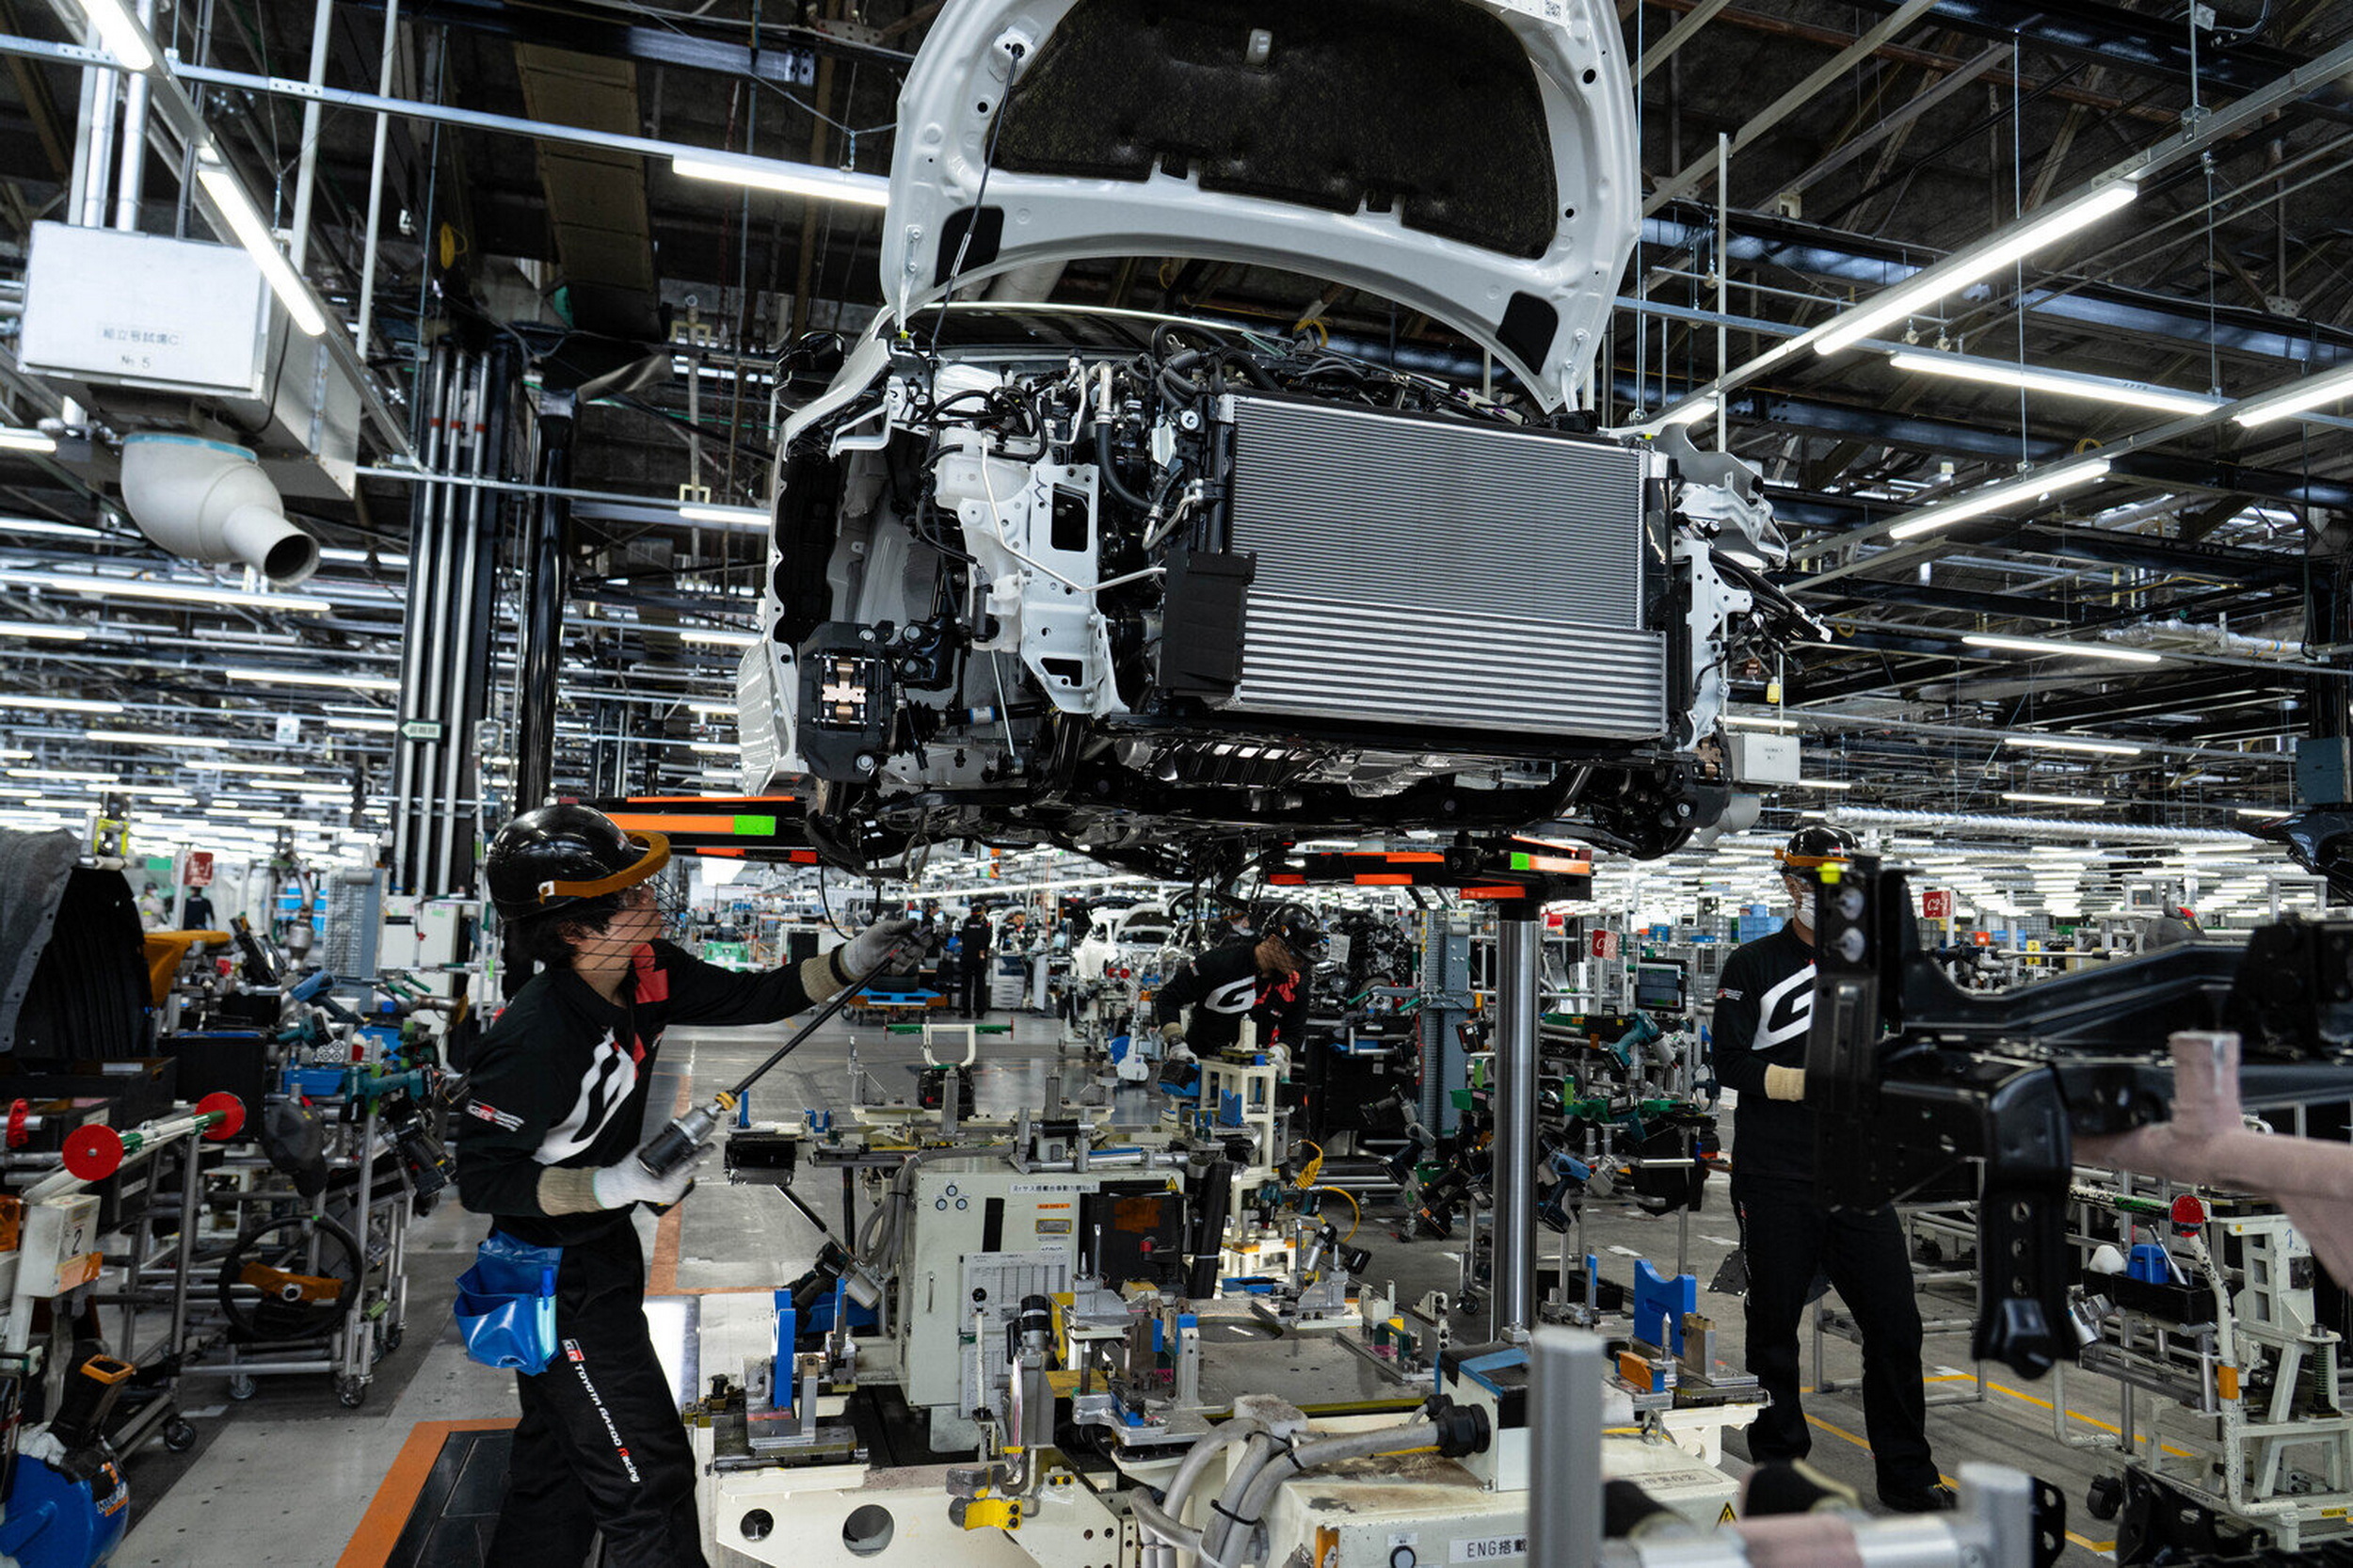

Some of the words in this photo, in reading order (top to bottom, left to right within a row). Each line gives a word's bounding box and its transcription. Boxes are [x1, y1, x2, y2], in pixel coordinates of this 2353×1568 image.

[72, 1228, 83, 1256] 2
[574, 1363, 602, 1407] TOYOTA
[599, 1407, 623, 1448] GAZOO
[617, 1448, 641, 1483] Racing
